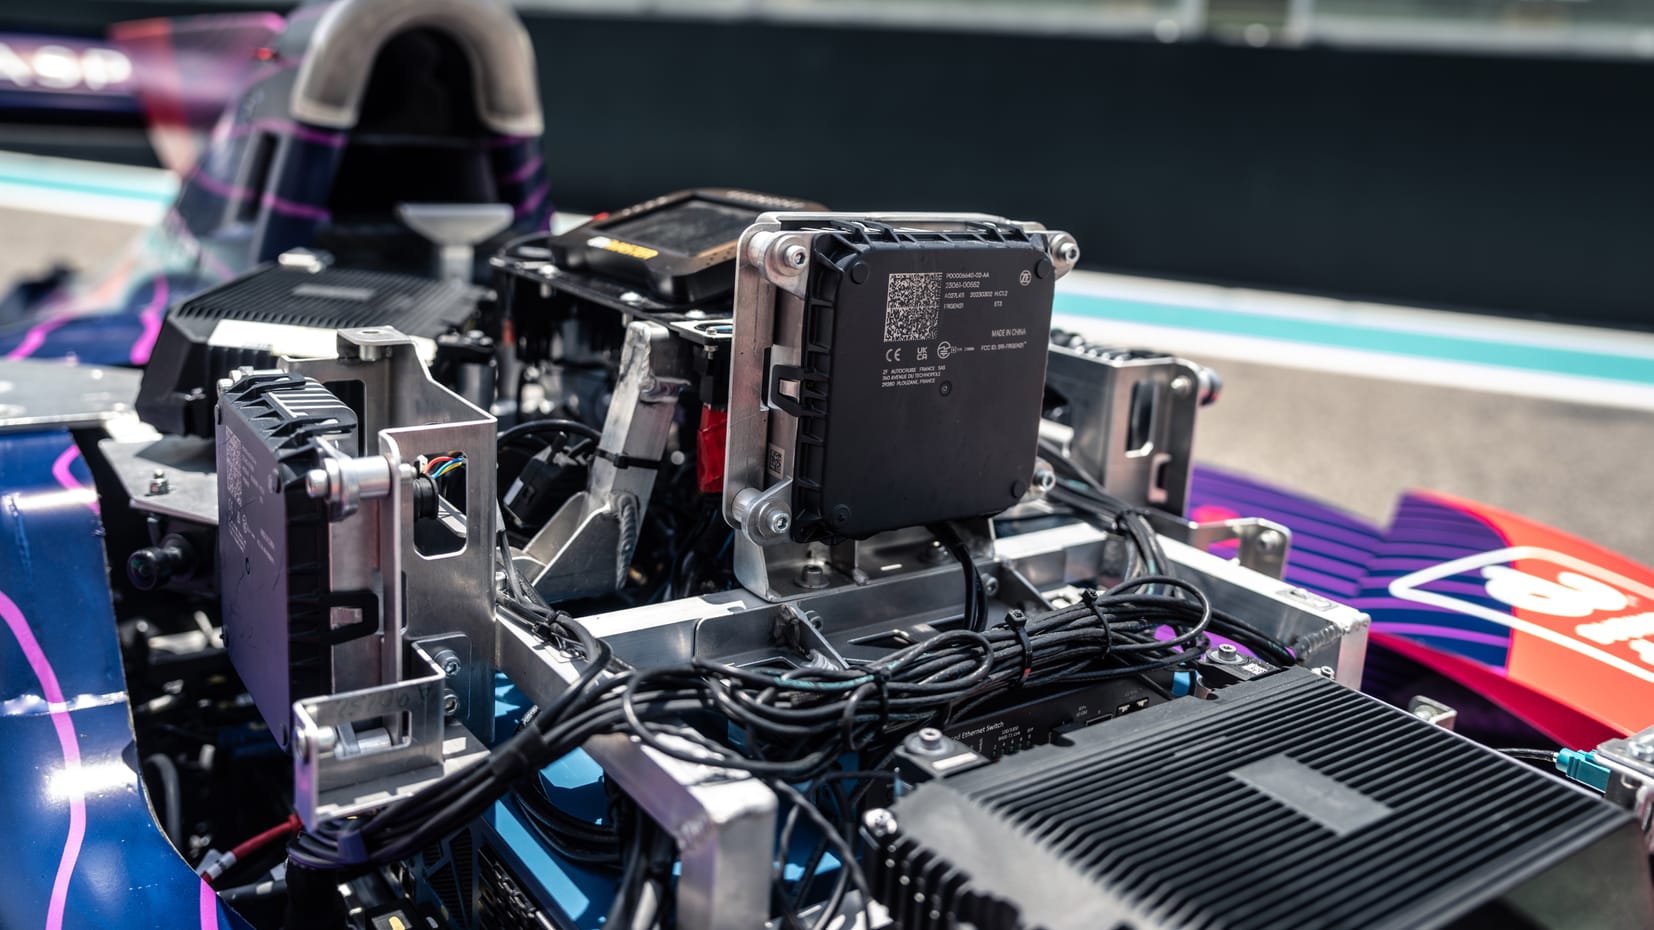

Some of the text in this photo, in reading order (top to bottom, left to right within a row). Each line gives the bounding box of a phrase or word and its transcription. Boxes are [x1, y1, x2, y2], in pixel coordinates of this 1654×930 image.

[991, 329, 1005, 337] MADE
[1011, 328, 1026, 336] CHINA
[962, 726, 986, 739] Ethernet
[986, 721, 1004, 732] Switch
